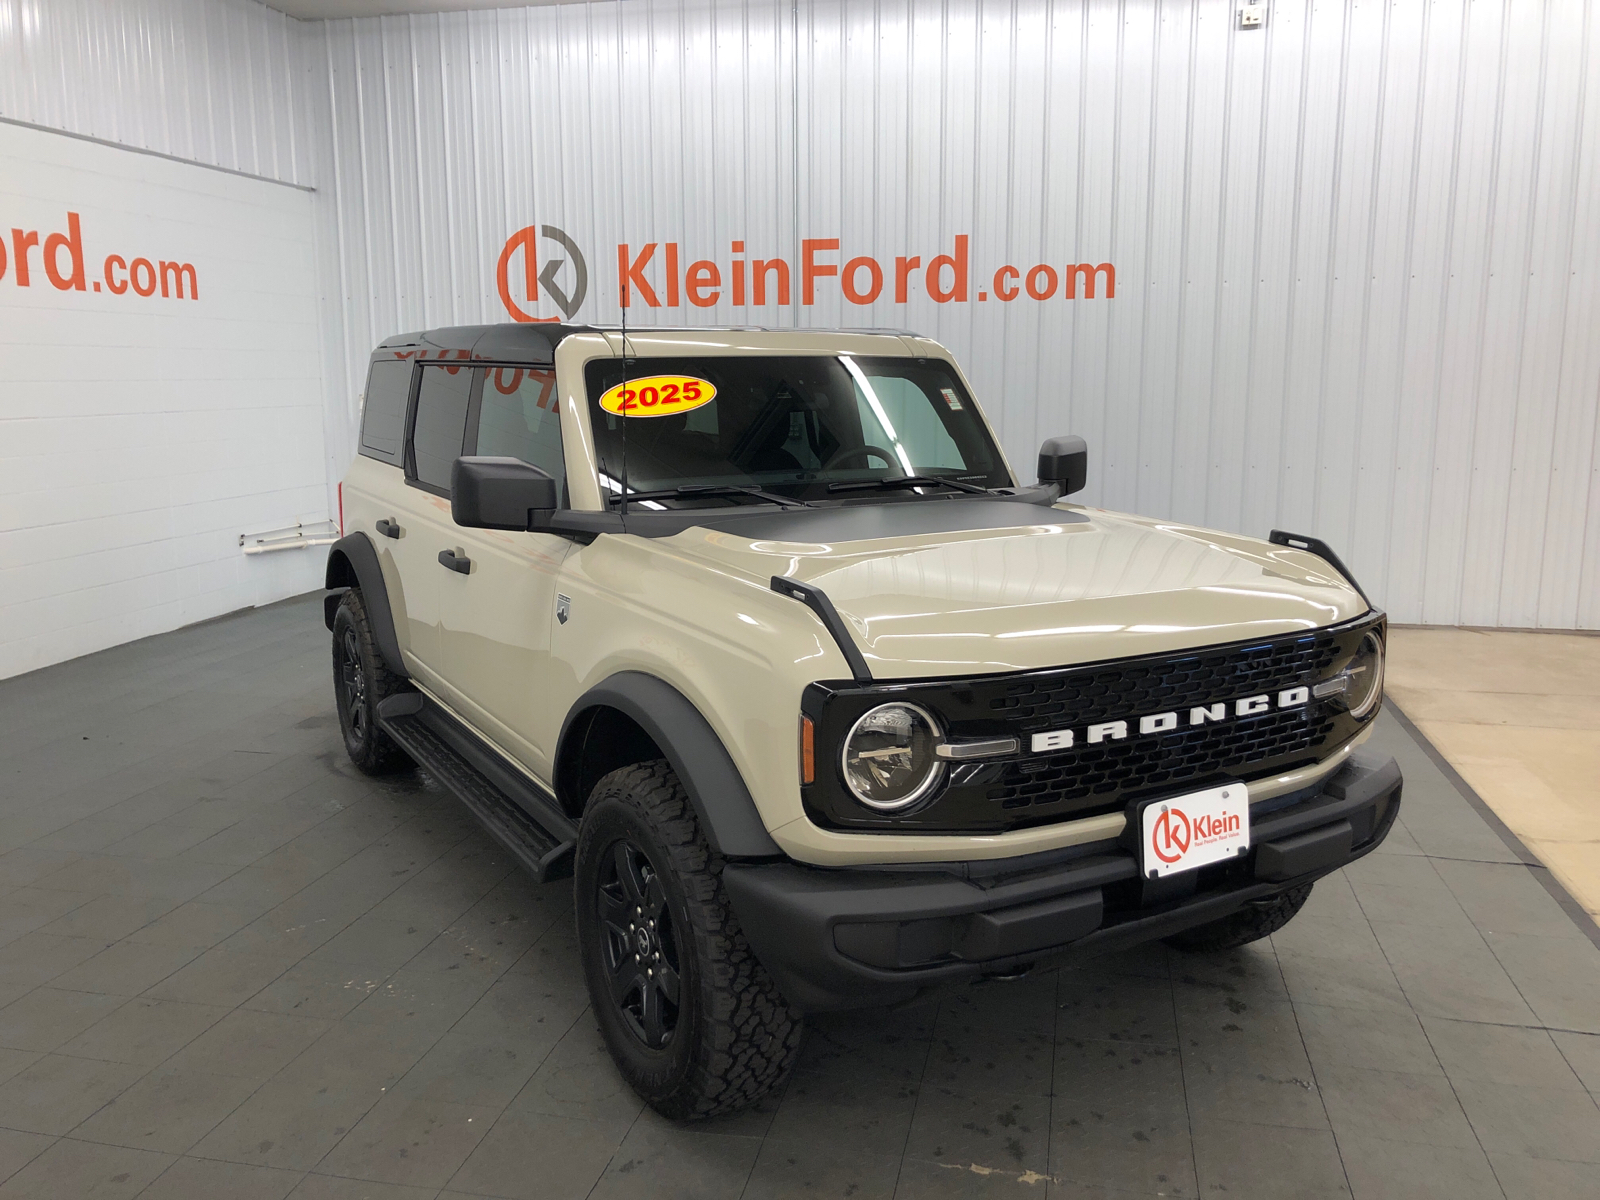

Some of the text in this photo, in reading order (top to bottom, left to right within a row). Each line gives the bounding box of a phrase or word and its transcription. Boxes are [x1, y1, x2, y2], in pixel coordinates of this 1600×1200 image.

[0, 211, 199, 301] rd.com
[617, 234, 1116, 308] KleinFord.com
[615, 380, 703, 411] 2025
[1031, 686, 1309, 752] BRONCO
[1193, 810, 1240, 841] Klein
